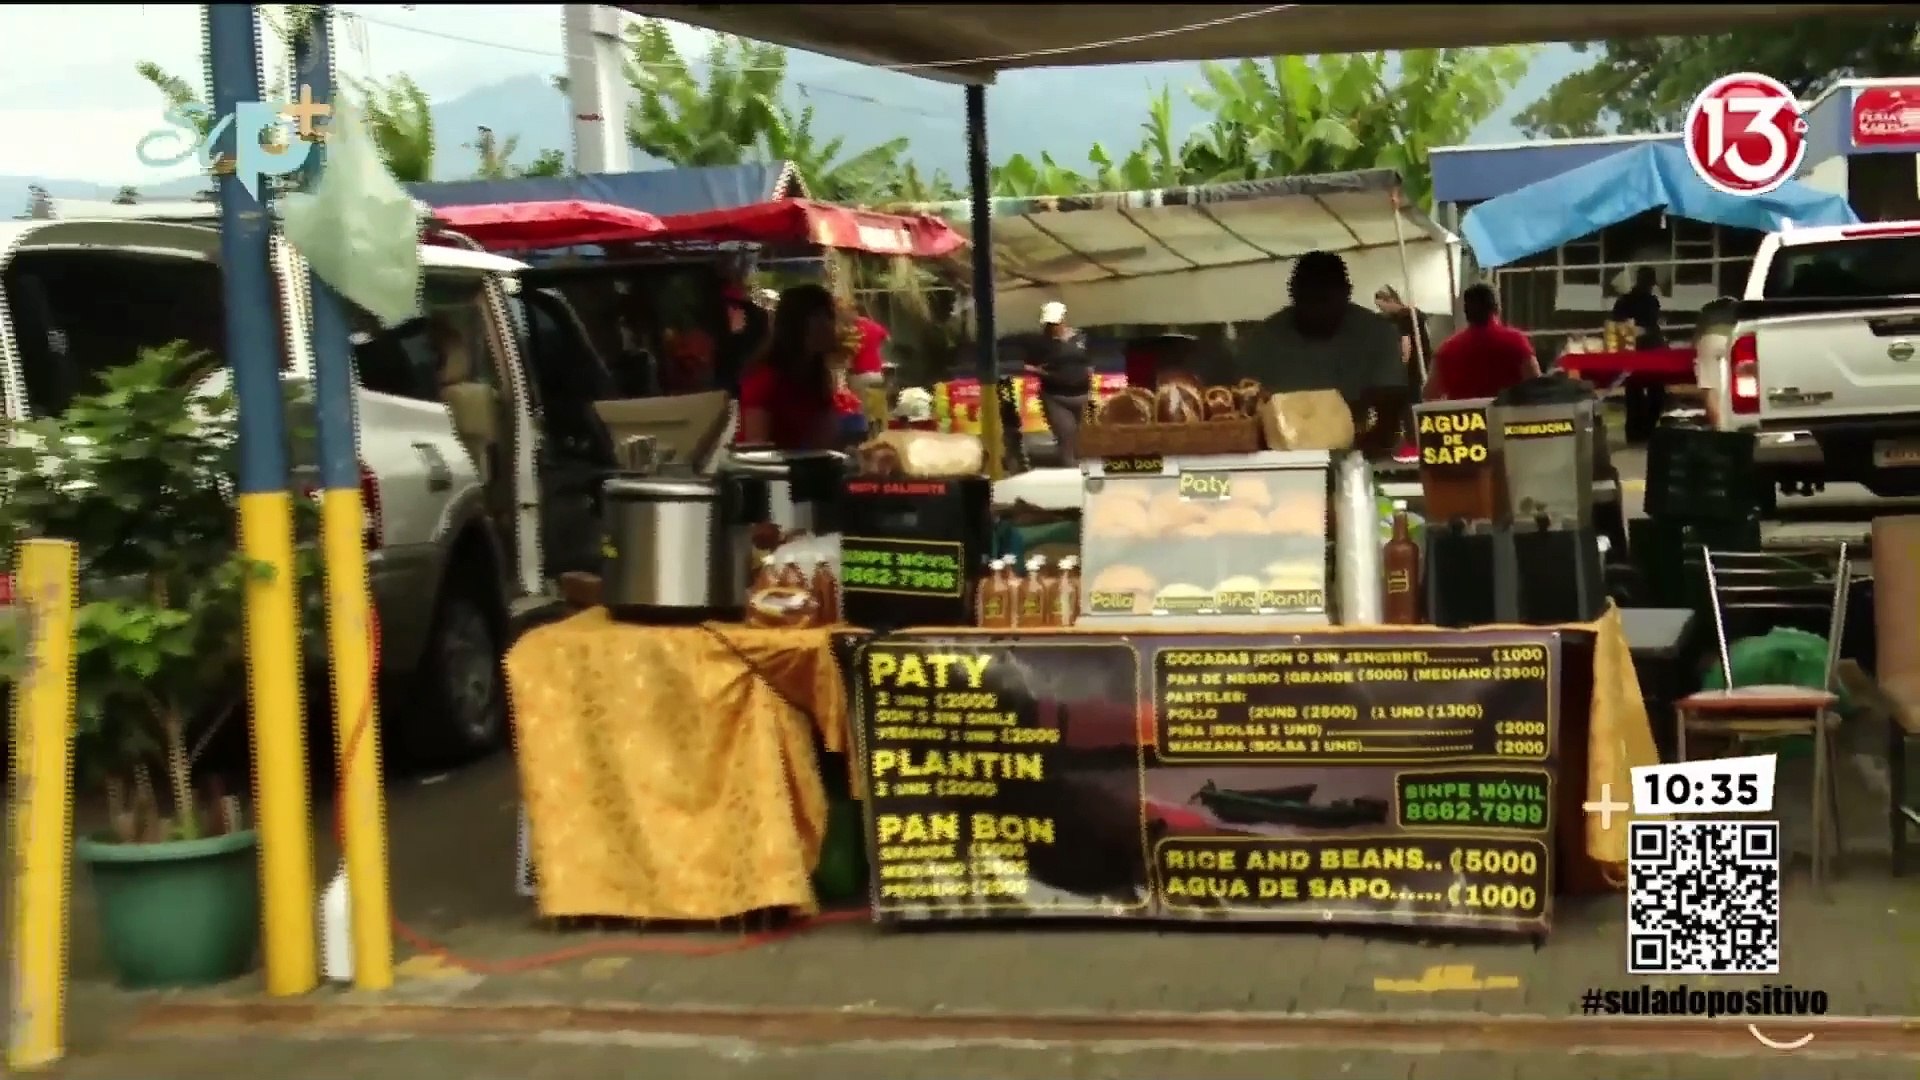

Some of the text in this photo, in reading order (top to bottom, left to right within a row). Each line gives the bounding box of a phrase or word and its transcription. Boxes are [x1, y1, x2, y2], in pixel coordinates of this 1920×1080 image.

[1420, 413, 1487, 433] AGUA
[1443, 434, 1463, 446] DE
[1423, 444, 1487, 465] SAPO
[1180, 472, 1230, 496] Paty
[1165, 652, 1249, 666] COCADAS
[1297, 653, 1309, 665] O
[1313, 652, 1340, 664] SIN
[868, 653, 993, 688] PATY
[1166, 672, 1198, 685] PAN
[1201, 672, 1222, 685] DE
[1390, 705, 1424, 718] UND
[872, 749, 1044, 782] PLANTIN
[1404, 779, 1546, 801] SINPE MÓVIL
[876, 812, 1056, 844] PAN BON
[1166, 850, 1237, 871] RICE
[1247, 850, 1311, 871] AND
[1166, 875, 1249, 898] AGUA
[1258, 876, 1298, 898] DE
